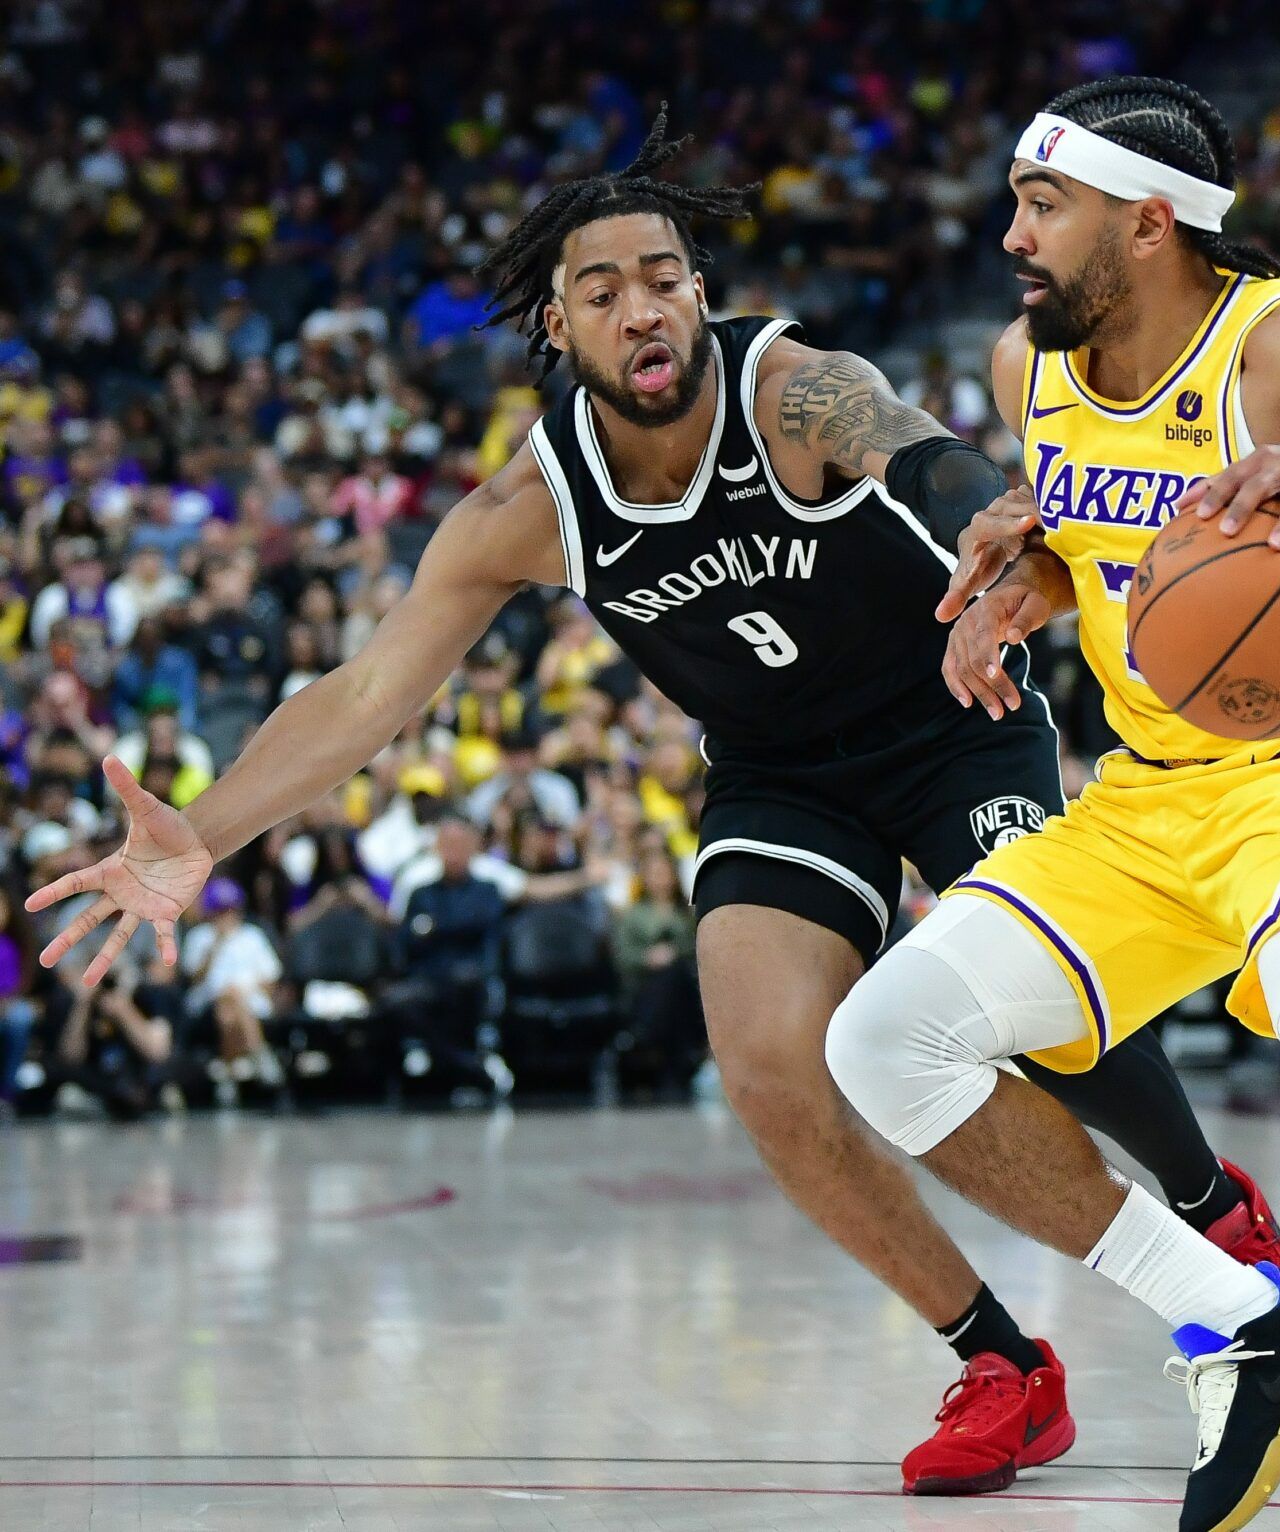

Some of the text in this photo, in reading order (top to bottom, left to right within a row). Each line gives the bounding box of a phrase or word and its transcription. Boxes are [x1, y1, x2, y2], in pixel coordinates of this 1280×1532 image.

[1165, 424, 1212, 447] bibigo
[725, 483, 767, 502] Webull
[1034, 441, 1207, 533] LAKER
[602, 533, 818, 623] BROOKLYN
[727, 611, 799, 668] 9
[975, 800, 1043, 838] NETS
